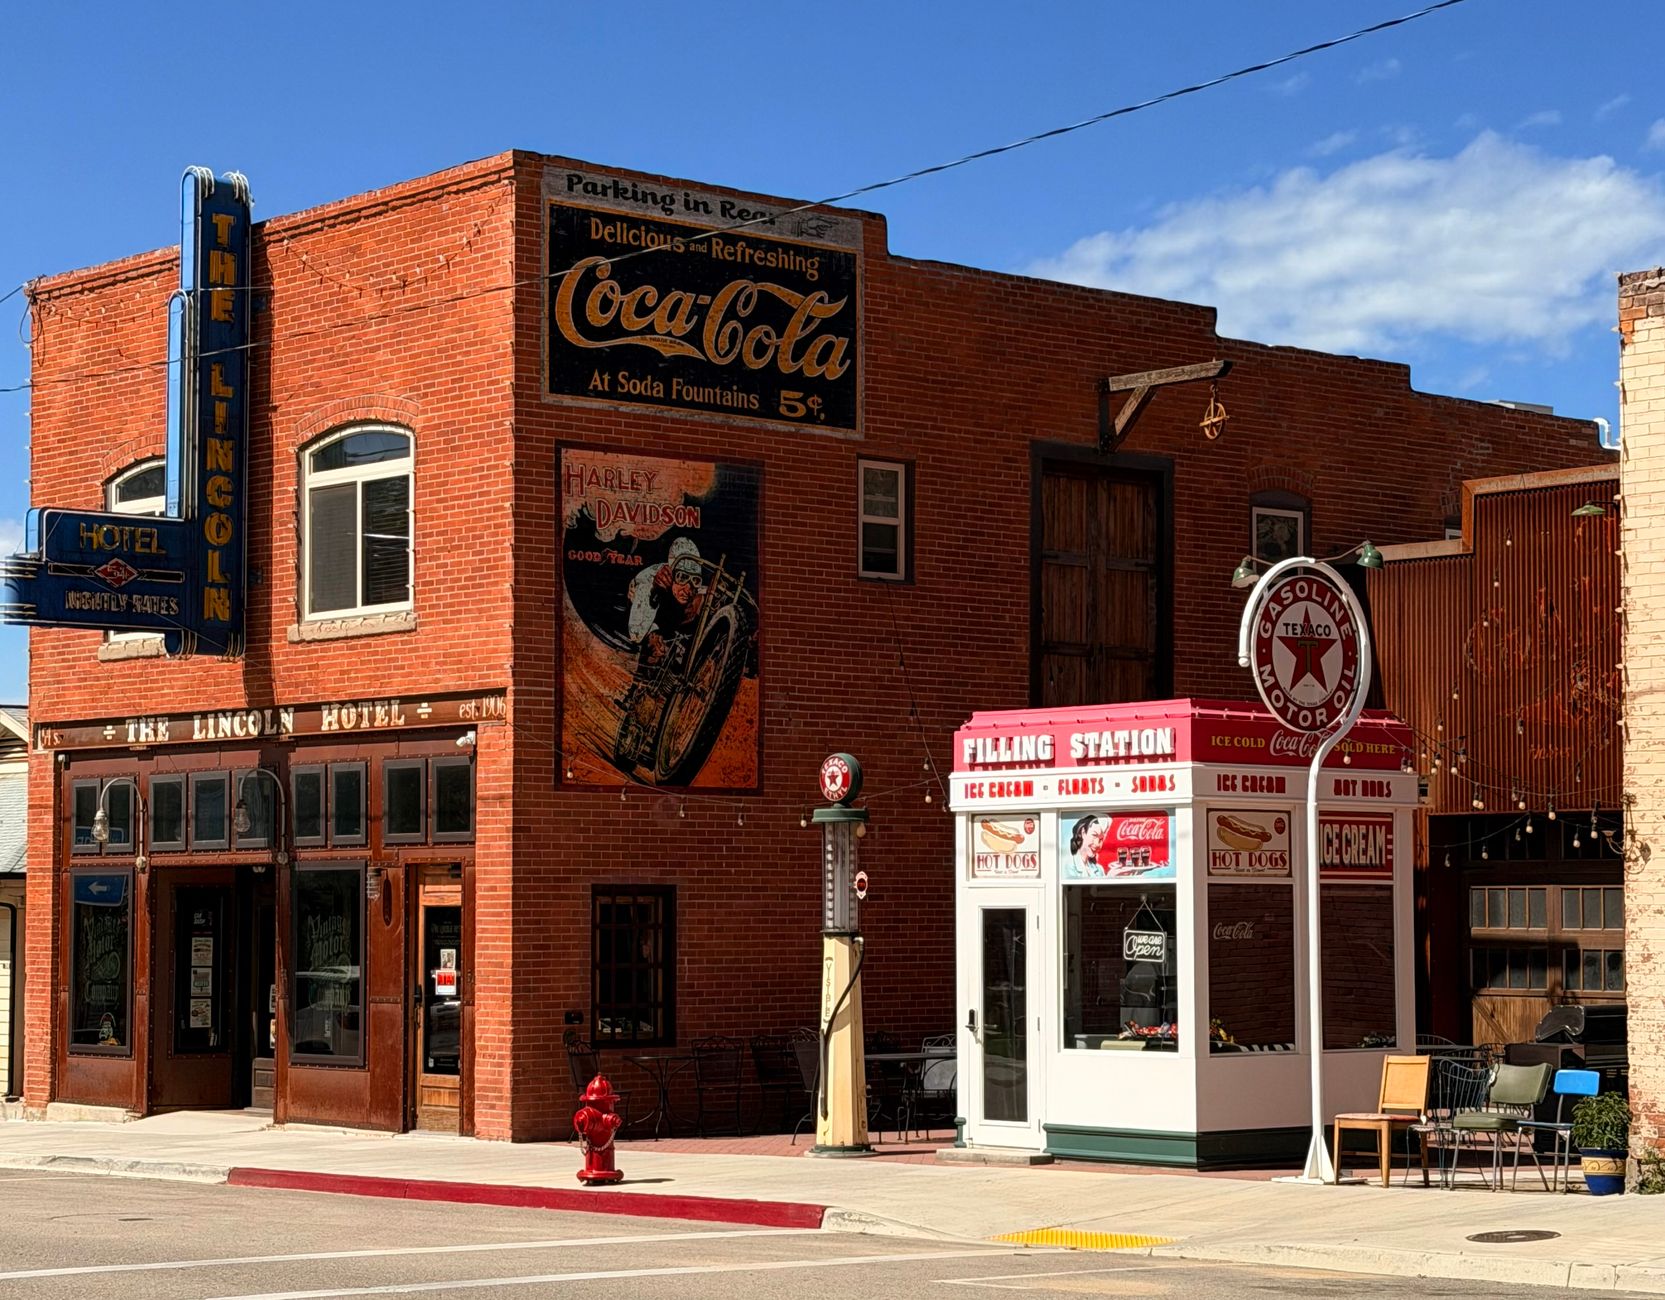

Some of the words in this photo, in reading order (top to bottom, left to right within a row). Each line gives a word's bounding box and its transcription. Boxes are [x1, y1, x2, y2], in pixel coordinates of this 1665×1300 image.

[566, 173, 675, 216] Parking
[683, 191, 713, 214] in
[719, 200, 776, 226] Rear
[590, 217, 686, 254] Delicious
[689, 240, 708, 254] and
[711, 238, 820, 281] Refreshing
[209, 213, 236, 323] THE
[555, 256, 851, 380] Coca-Cola
[589, 368, 610, 392] At
[617, 371, 665, 399] Soda
[671, 377, 759, 410] Fountains
[204, 363, 235, 621] LINCOLN
[565, 462, 660, 497] HARLEY
[595, 497, 701, 529] DAVIDSON
[79, 521, 167, 554] HOTEL
[568, 550, 602, 562] GOOD
[607, 550, 643, 566] YEAR
[65, 590, 128, 612] NIGHTLY
[132, 594, 179, 615] RATES
[1259, 581, 1353, 640] GASOLINE
[1282, 622, 1332, 637] TEXACO
[1260, 663, 1328, 727] MOTOR
[1333, 664, 1355, 709] OIL
[125, 716, 169, 742] THE
[193, 707, 294, 739] LINCOLN
[320, 700, 405, 731] HOTEL
[482, 694, 507, 718] 1906
[963, 734, 1055, 763] FILLING
[1070, 727, 1176, 759] STATION
[1211, 735, 1232, 747] ICE
[1233, 736, 1265, 748] COLD
[1334, 741, 1364, 753] SOLD
[1366, 741, 1396, 754] HERE
[821, 757, 849, 774] TEXACO
[824, 786, 848, 800] ETHYL
[964, 782, 984, 799] ICE
[989, 780, 1034, 798] CREAM
[1058, 777, 1105, 796] FLOATS
[1131, 774, 1176, 793] SODAS
[1217, 773, 1238, 792] ICE
[1241, 775, 1286, 794] CREAM
[1333, 778, 1358, 797] HOT
[1361, 780, 1392, 798] DOGS
[1212, 851, 1242, 868] HOT
[1248, 852, 1287, 868] DOGS
[1319, 823, 1340, 865] ICE
[1342, 823, 1387, 865] CREAM
[976, 854, 1000, 870] HOT
[1005, 853, 1038, 869] DOGS
[1126, 935, 1164, 960] Open
[1137, 935, 1149, 944] we
[1148, 935, 1163, 945] are
